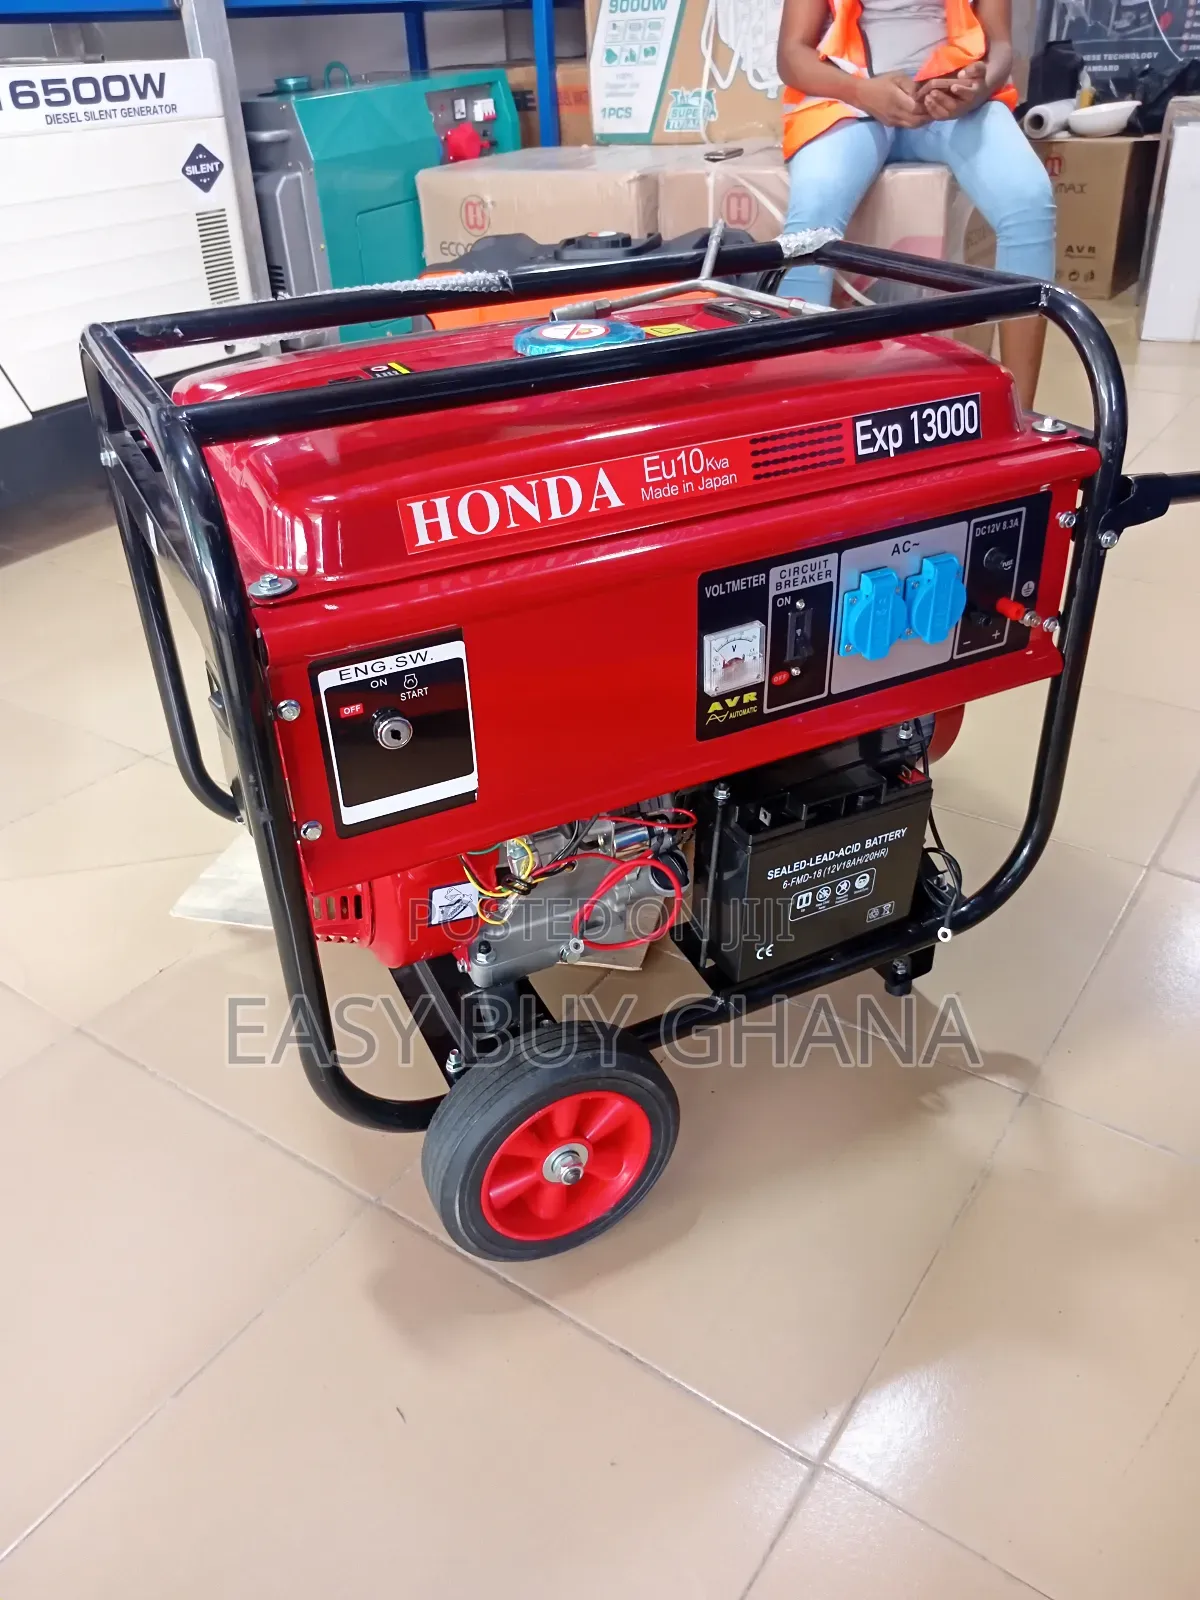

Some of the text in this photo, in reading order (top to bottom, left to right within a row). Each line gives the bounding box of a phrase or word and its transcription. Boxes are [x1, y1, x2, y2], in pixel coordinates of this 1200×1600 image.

[1103, 52, 1159, 61] TECHNOLOGY
[45, 104, 178, 125] DIESEL SILENT GENERATOR
[601, 107, 632, 119] 1PCS
[185, 161, 220, 176] SILENT
[855, 400, 979, 458] Exp 13000
[640, 473, 738, 502] Made in Japan
[407, 467, 626, 547] HONDA
[975, 518, 1020, 537] DC12V 8.3A
[779, 559, 829, 580] CIRCUIT
[704, 573, 766, 599] VOLTMETER
[775, 570, 832, 592] BREAKER
[776, 596, 792, 608] ON
[731, 644, 737, 652] V
[339, 650, 434, 682] ENG.SW.
[370, 677, 388, 689] ON
[773, 673, 788, 682] OFF
[400, 686, 429, 701] START
[707, 691, 758, 714] AVR
[343, 705, 361, 715] OFF
[728, 705, 758, 719] AUTOMATIC
[767, 827, 908, 881] SEALED-LEAD-ACID BATTERY
